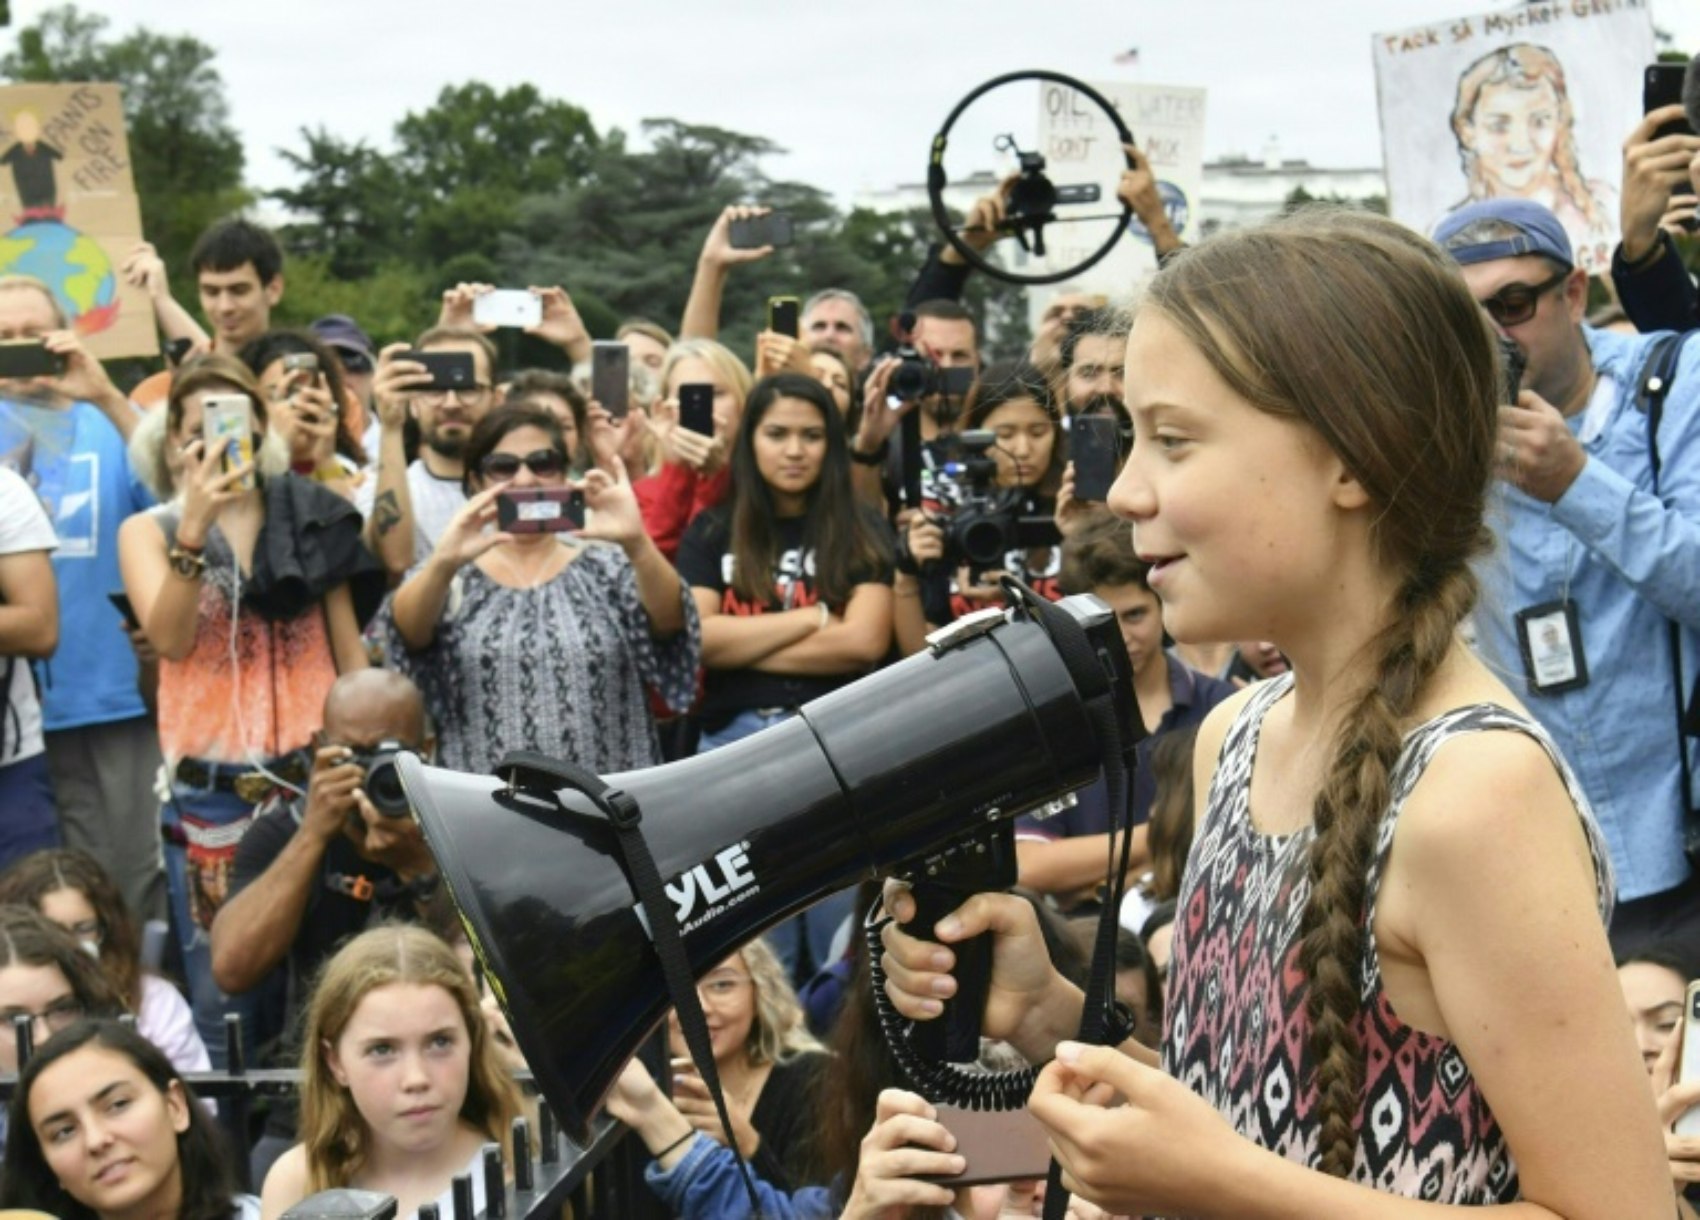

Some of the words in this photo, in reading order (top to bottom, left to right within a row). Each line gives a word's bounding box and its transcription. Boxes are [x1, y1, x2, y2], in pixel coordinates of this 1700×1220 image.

[43, 86, 104, 150] PANTS
[1046, 88, 1088, 116] OIL
[79, 119, 114, 155] ON
[72, 145, 128, 191] FIRE
[633, 843, 756, 940] YLE
